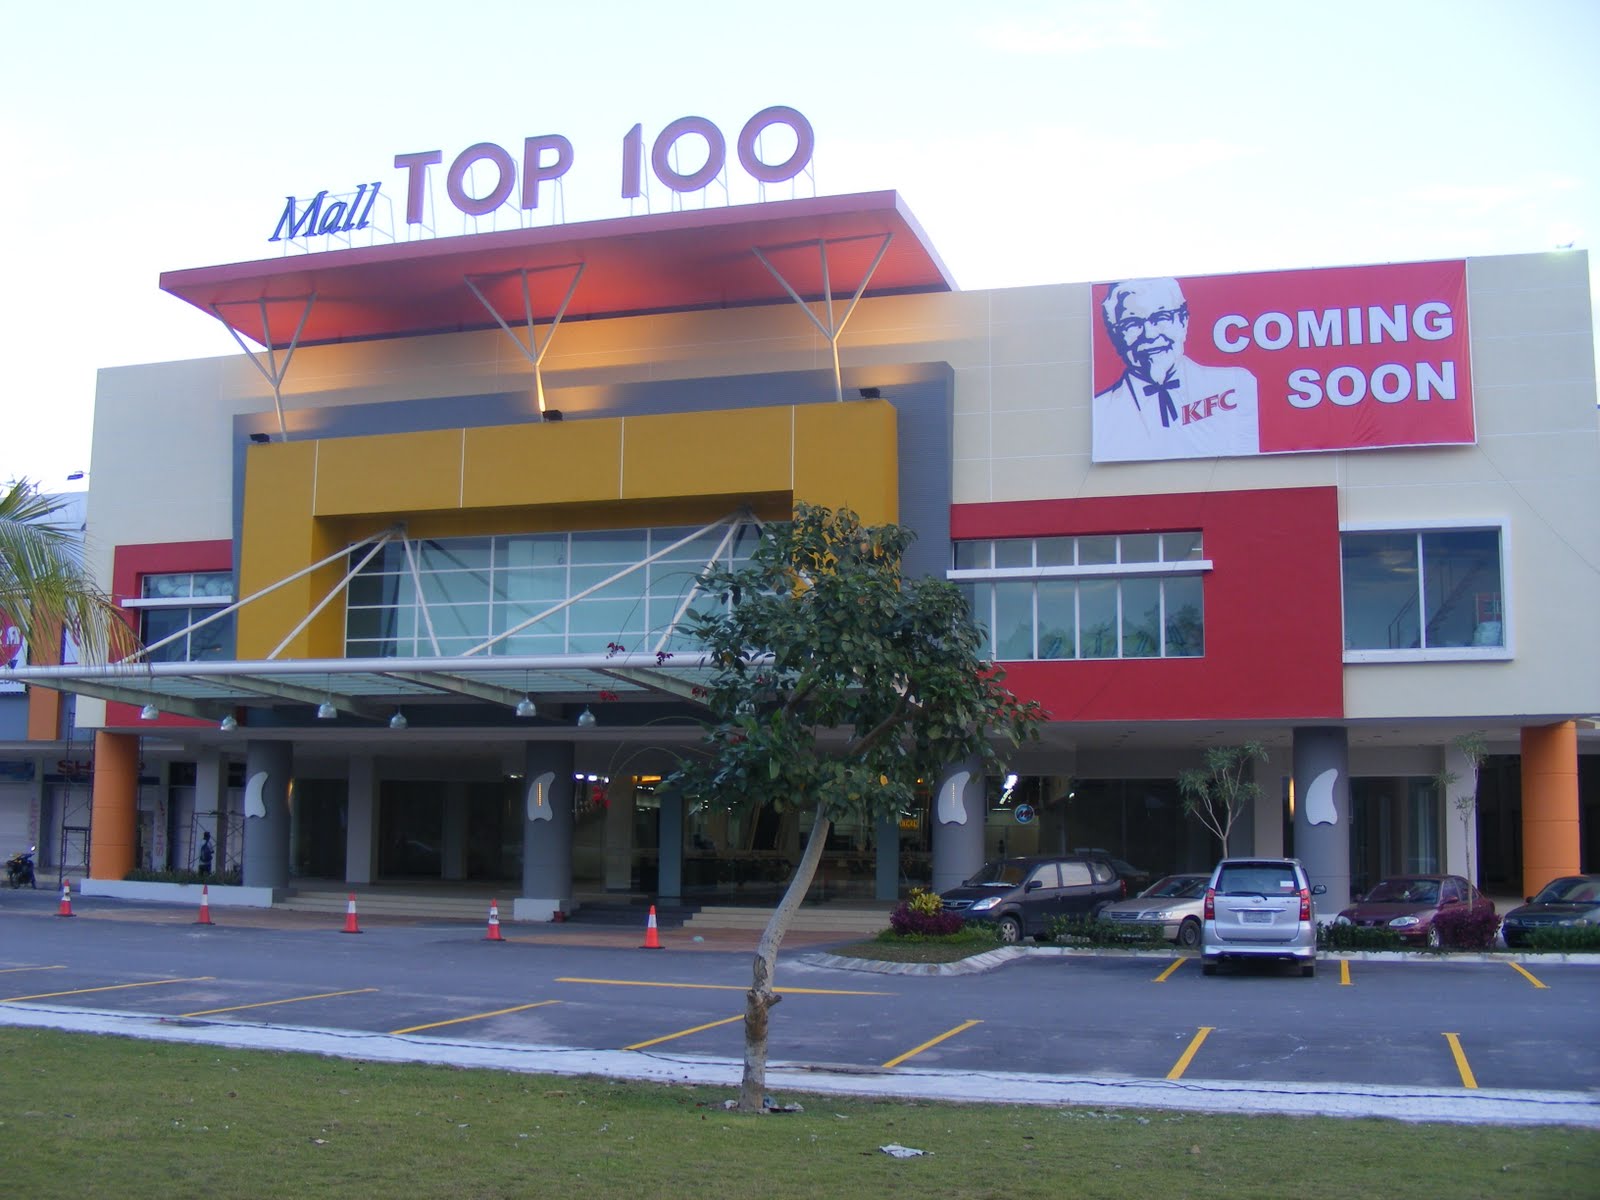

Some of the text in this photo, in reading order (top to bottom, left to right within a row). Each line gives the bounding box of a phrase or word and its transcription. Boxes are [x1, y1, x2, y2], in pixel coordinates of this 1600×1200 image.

[269, 105, 815, 242] Mall TOP 100
[1212, 301, 1454, 353] COMING
[1181, 389, 1238, 426] KFC
[1286, 361, 1457, 409] SOON
